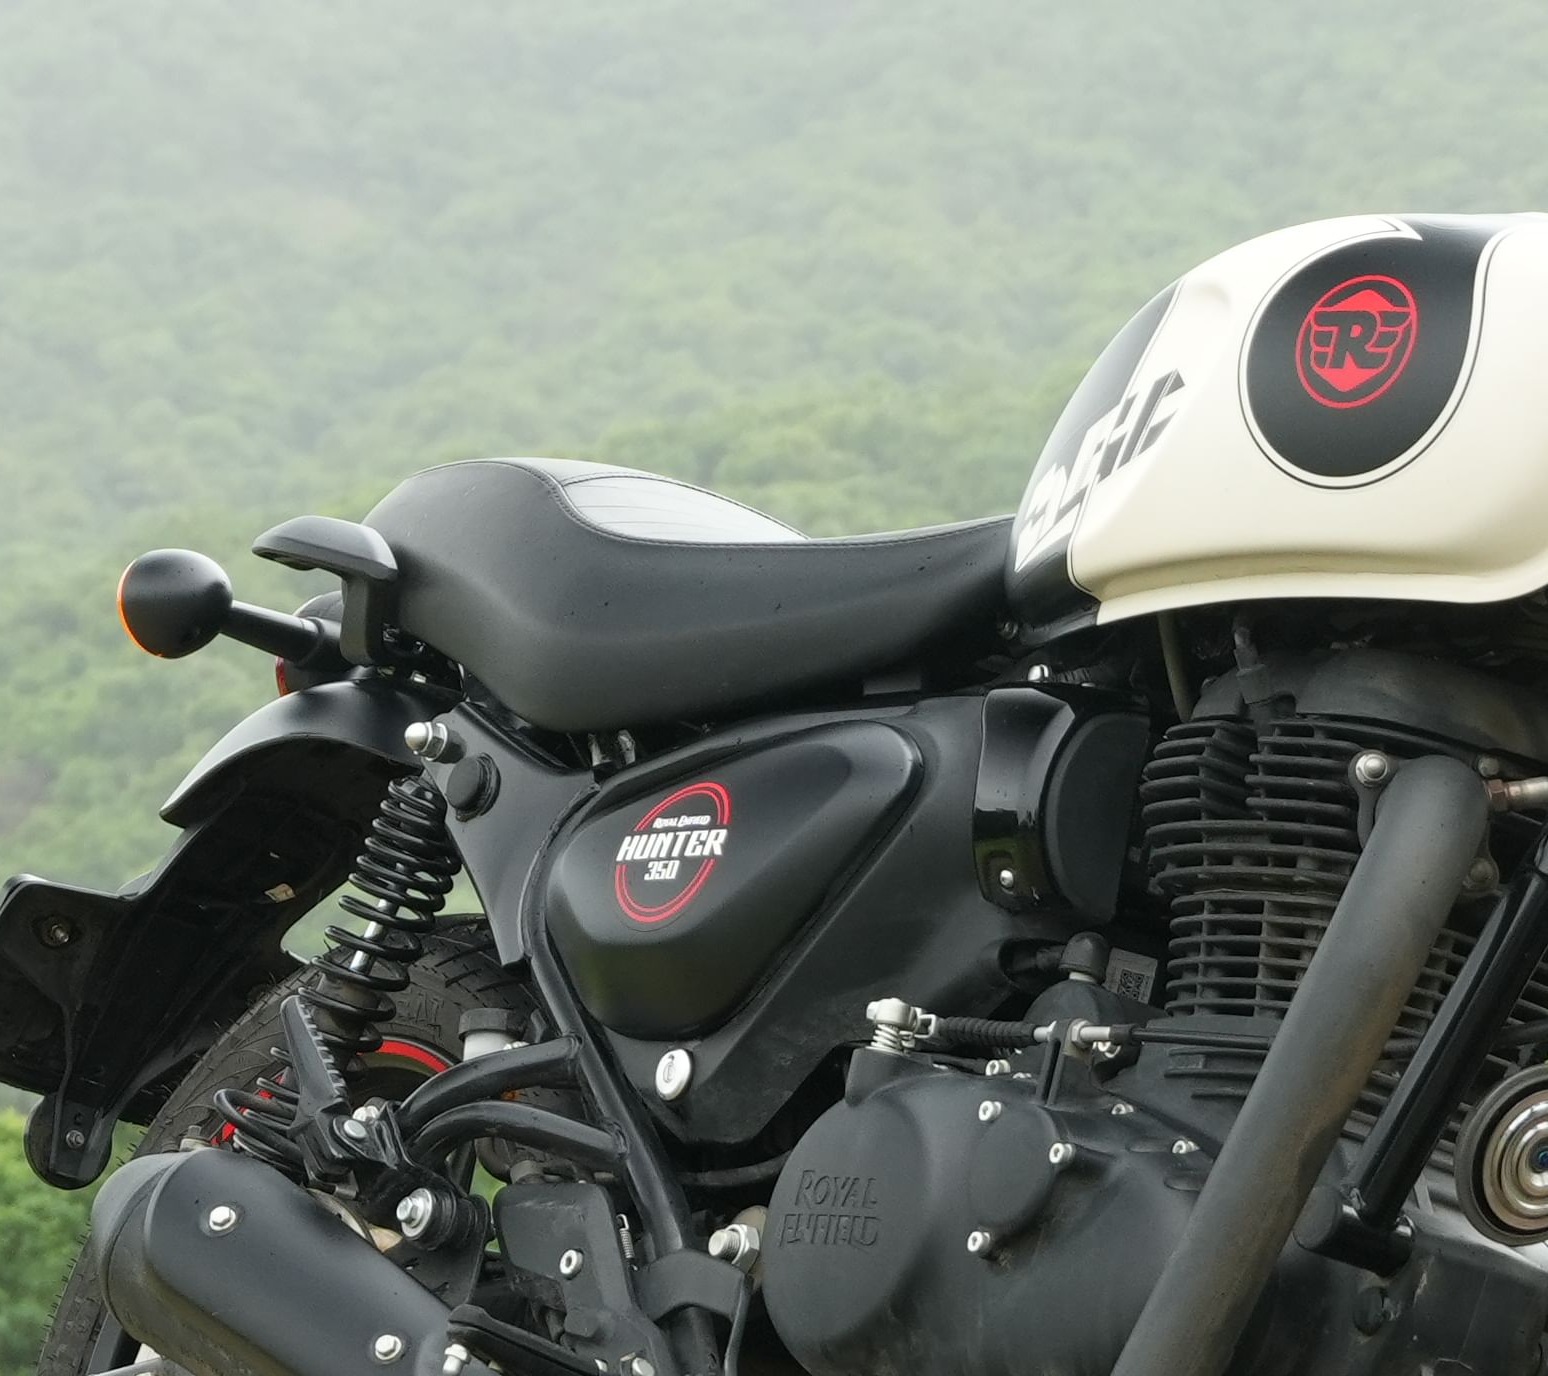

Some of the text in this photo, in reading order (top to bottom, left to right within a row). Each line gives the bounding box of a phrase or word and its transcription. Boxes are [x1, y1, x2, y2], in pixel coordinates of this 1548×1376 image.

[616, 829, 728, 861] HUNTER
[643, 859, 680, 881] 350
[794, 1169, 879, 1210] ROYAL
[778, 1213, 883, 1249] ENFIELD
